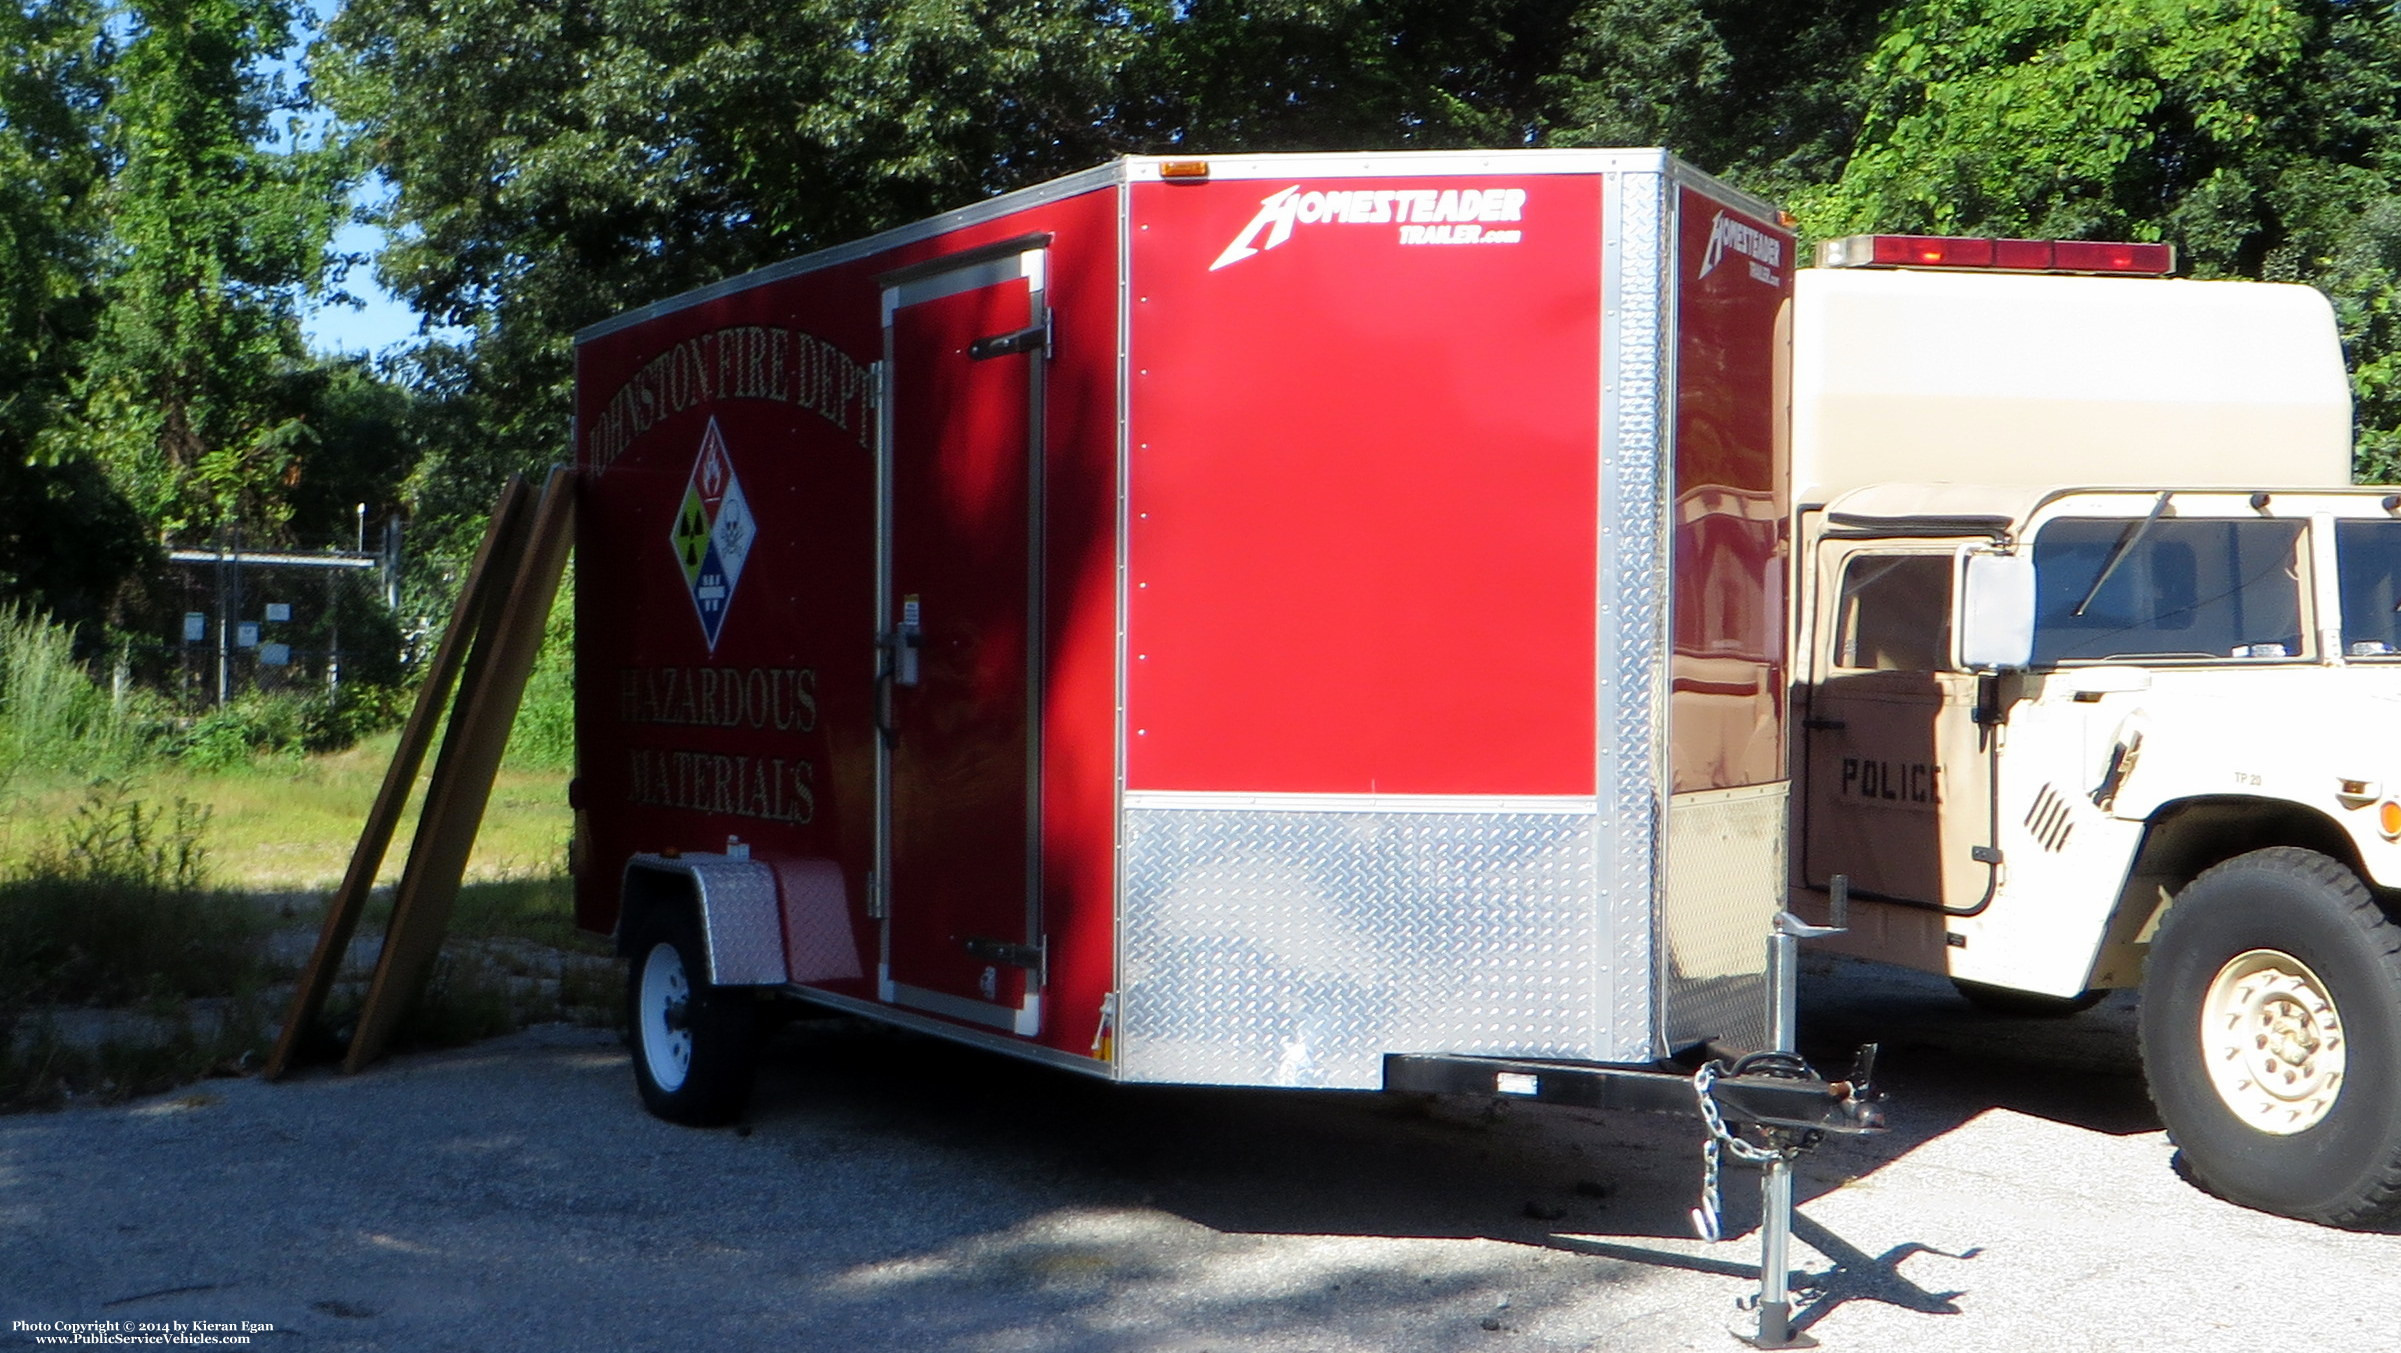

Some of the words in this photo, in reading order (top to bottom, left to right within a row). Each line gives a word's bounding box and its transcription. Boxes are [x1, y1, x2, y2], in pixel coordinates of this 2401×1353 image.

[1208, 185, 1526, 272] HOMESTEADER
[589, 334, 714, 479] JOHNSTON
[715, 326, 789, 401] FIRE
[618, 667, 817, 732] HAZARDOUS
[626, 748, 816, 825] MATERIALS
